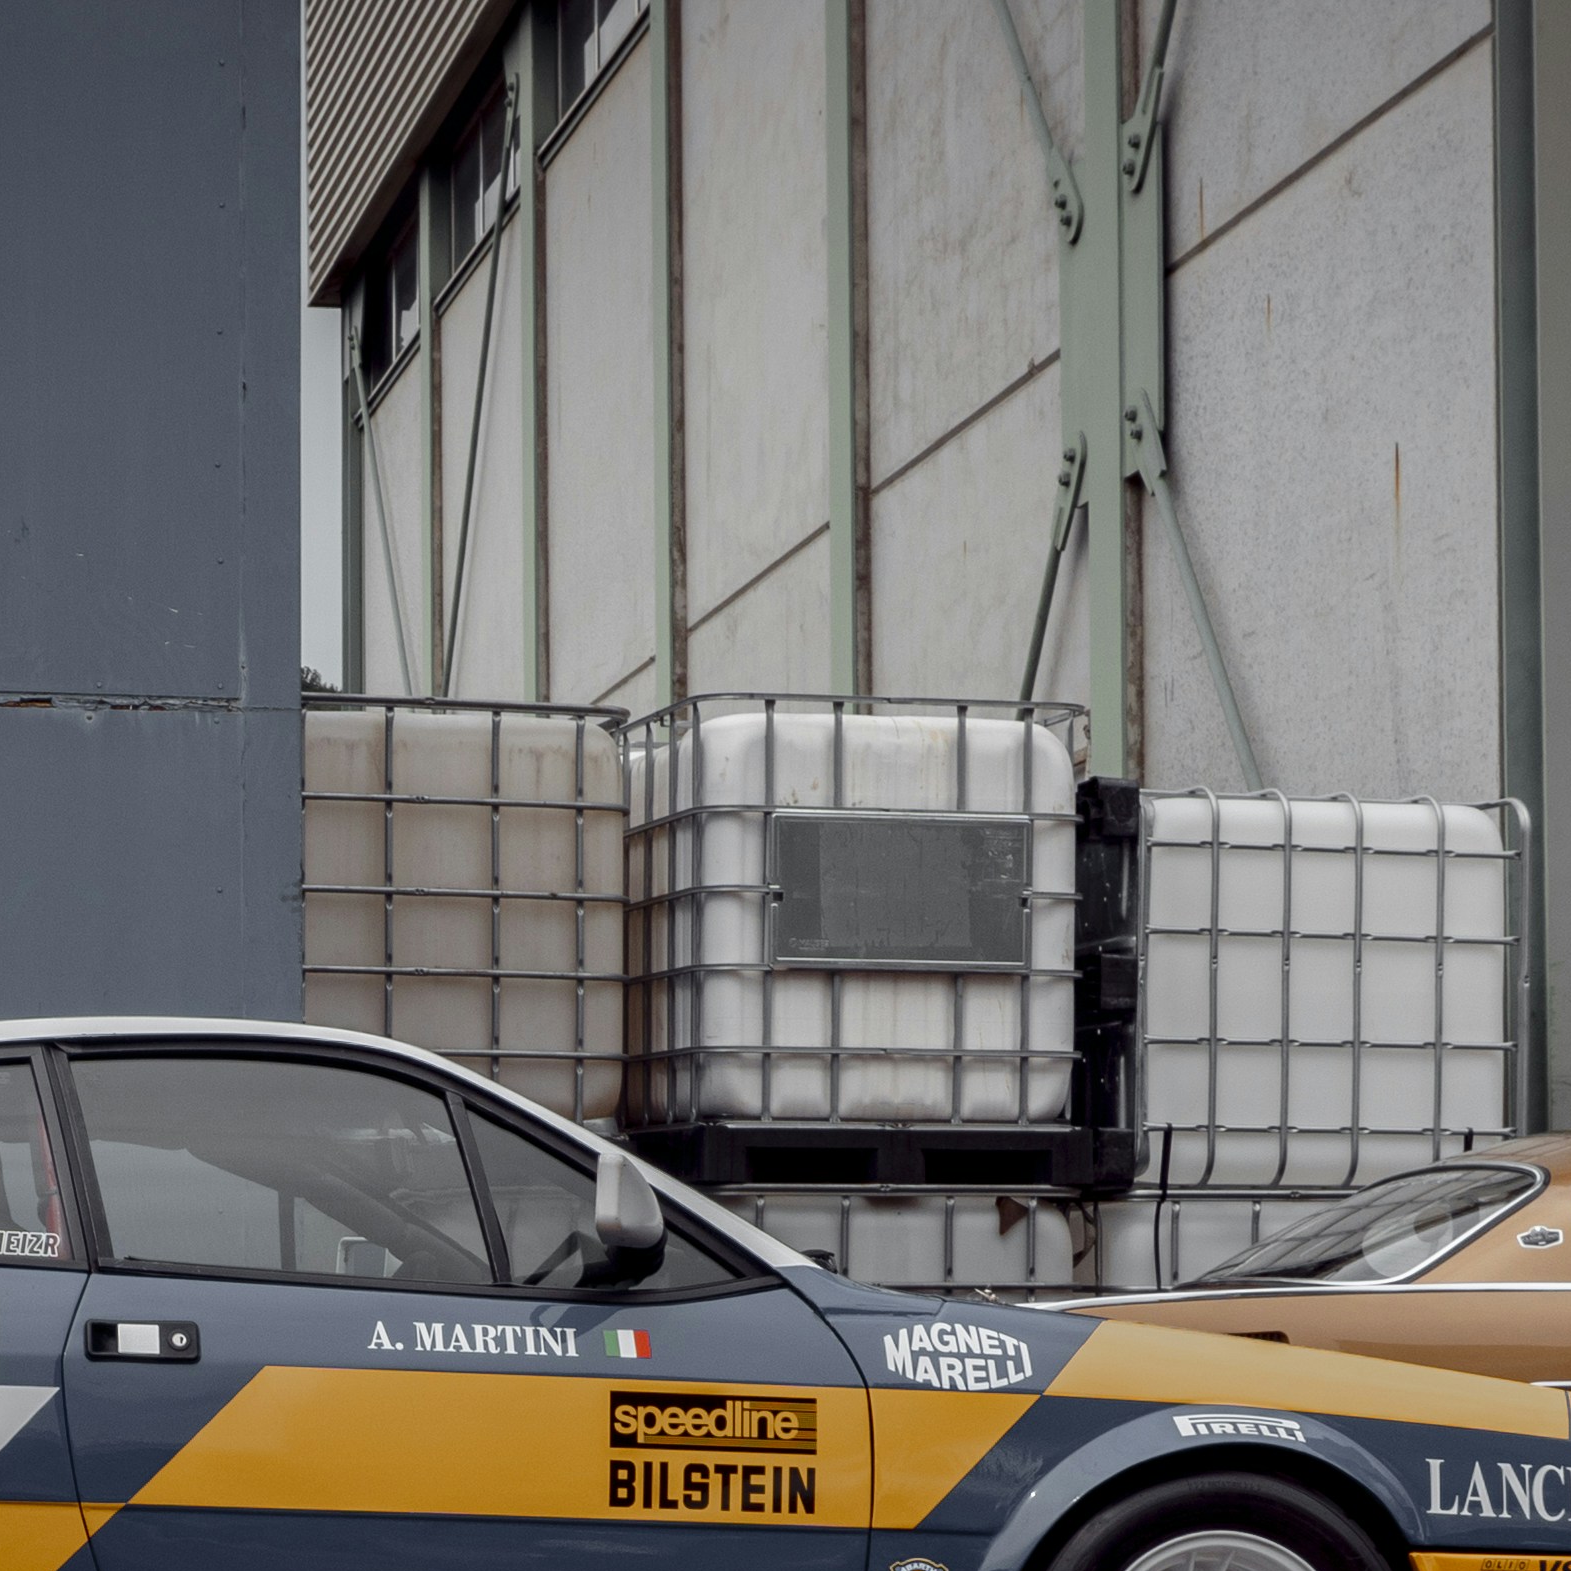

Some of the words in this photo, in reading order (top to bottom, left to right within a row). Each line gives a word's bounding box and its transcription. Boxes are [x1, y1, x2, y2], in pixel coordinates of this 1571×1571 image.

[367, 1321, 404, 1350] A.
[412, 1322, 580, 1357] MARTINI
[883, 1322, 1033, 1380] MAGNETI
[883, 1328, 1033, 1392] MARELLI
[613, 1400, 800, 1444] speedline
[1172, 1413, 1307, 1443] PIRELLI
[609, 1460, 816, 1514] BILSTEIN
[1485, 1560, 1526, 1570] OLIO
